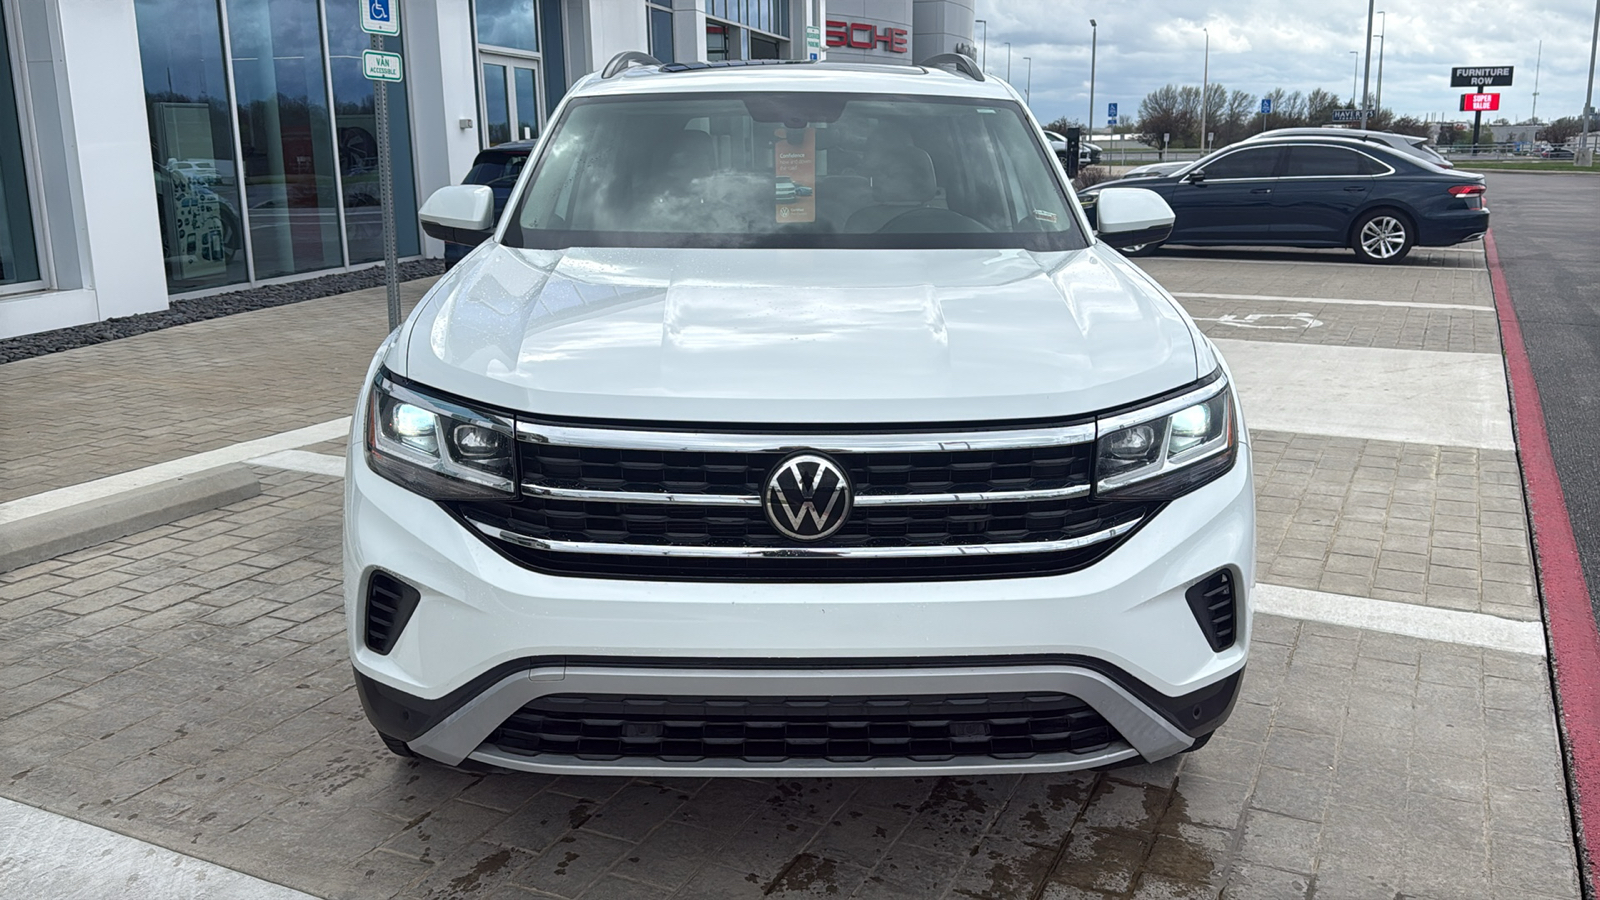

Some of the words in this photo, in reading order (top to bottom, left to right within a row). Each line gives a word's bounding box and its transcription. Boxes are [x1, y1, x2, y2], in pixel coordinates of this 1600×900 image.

[376, 58, 390, 67] VAN
[370, 67, 396, 75] ACCESSIBLE
[1456, 68, 1510, 77] FURNITURE
[1470, 77, 1494, 85] ROW
[1334, 110, 1374, 118] HAVERYS
[768, 457, 847, 537] VW
